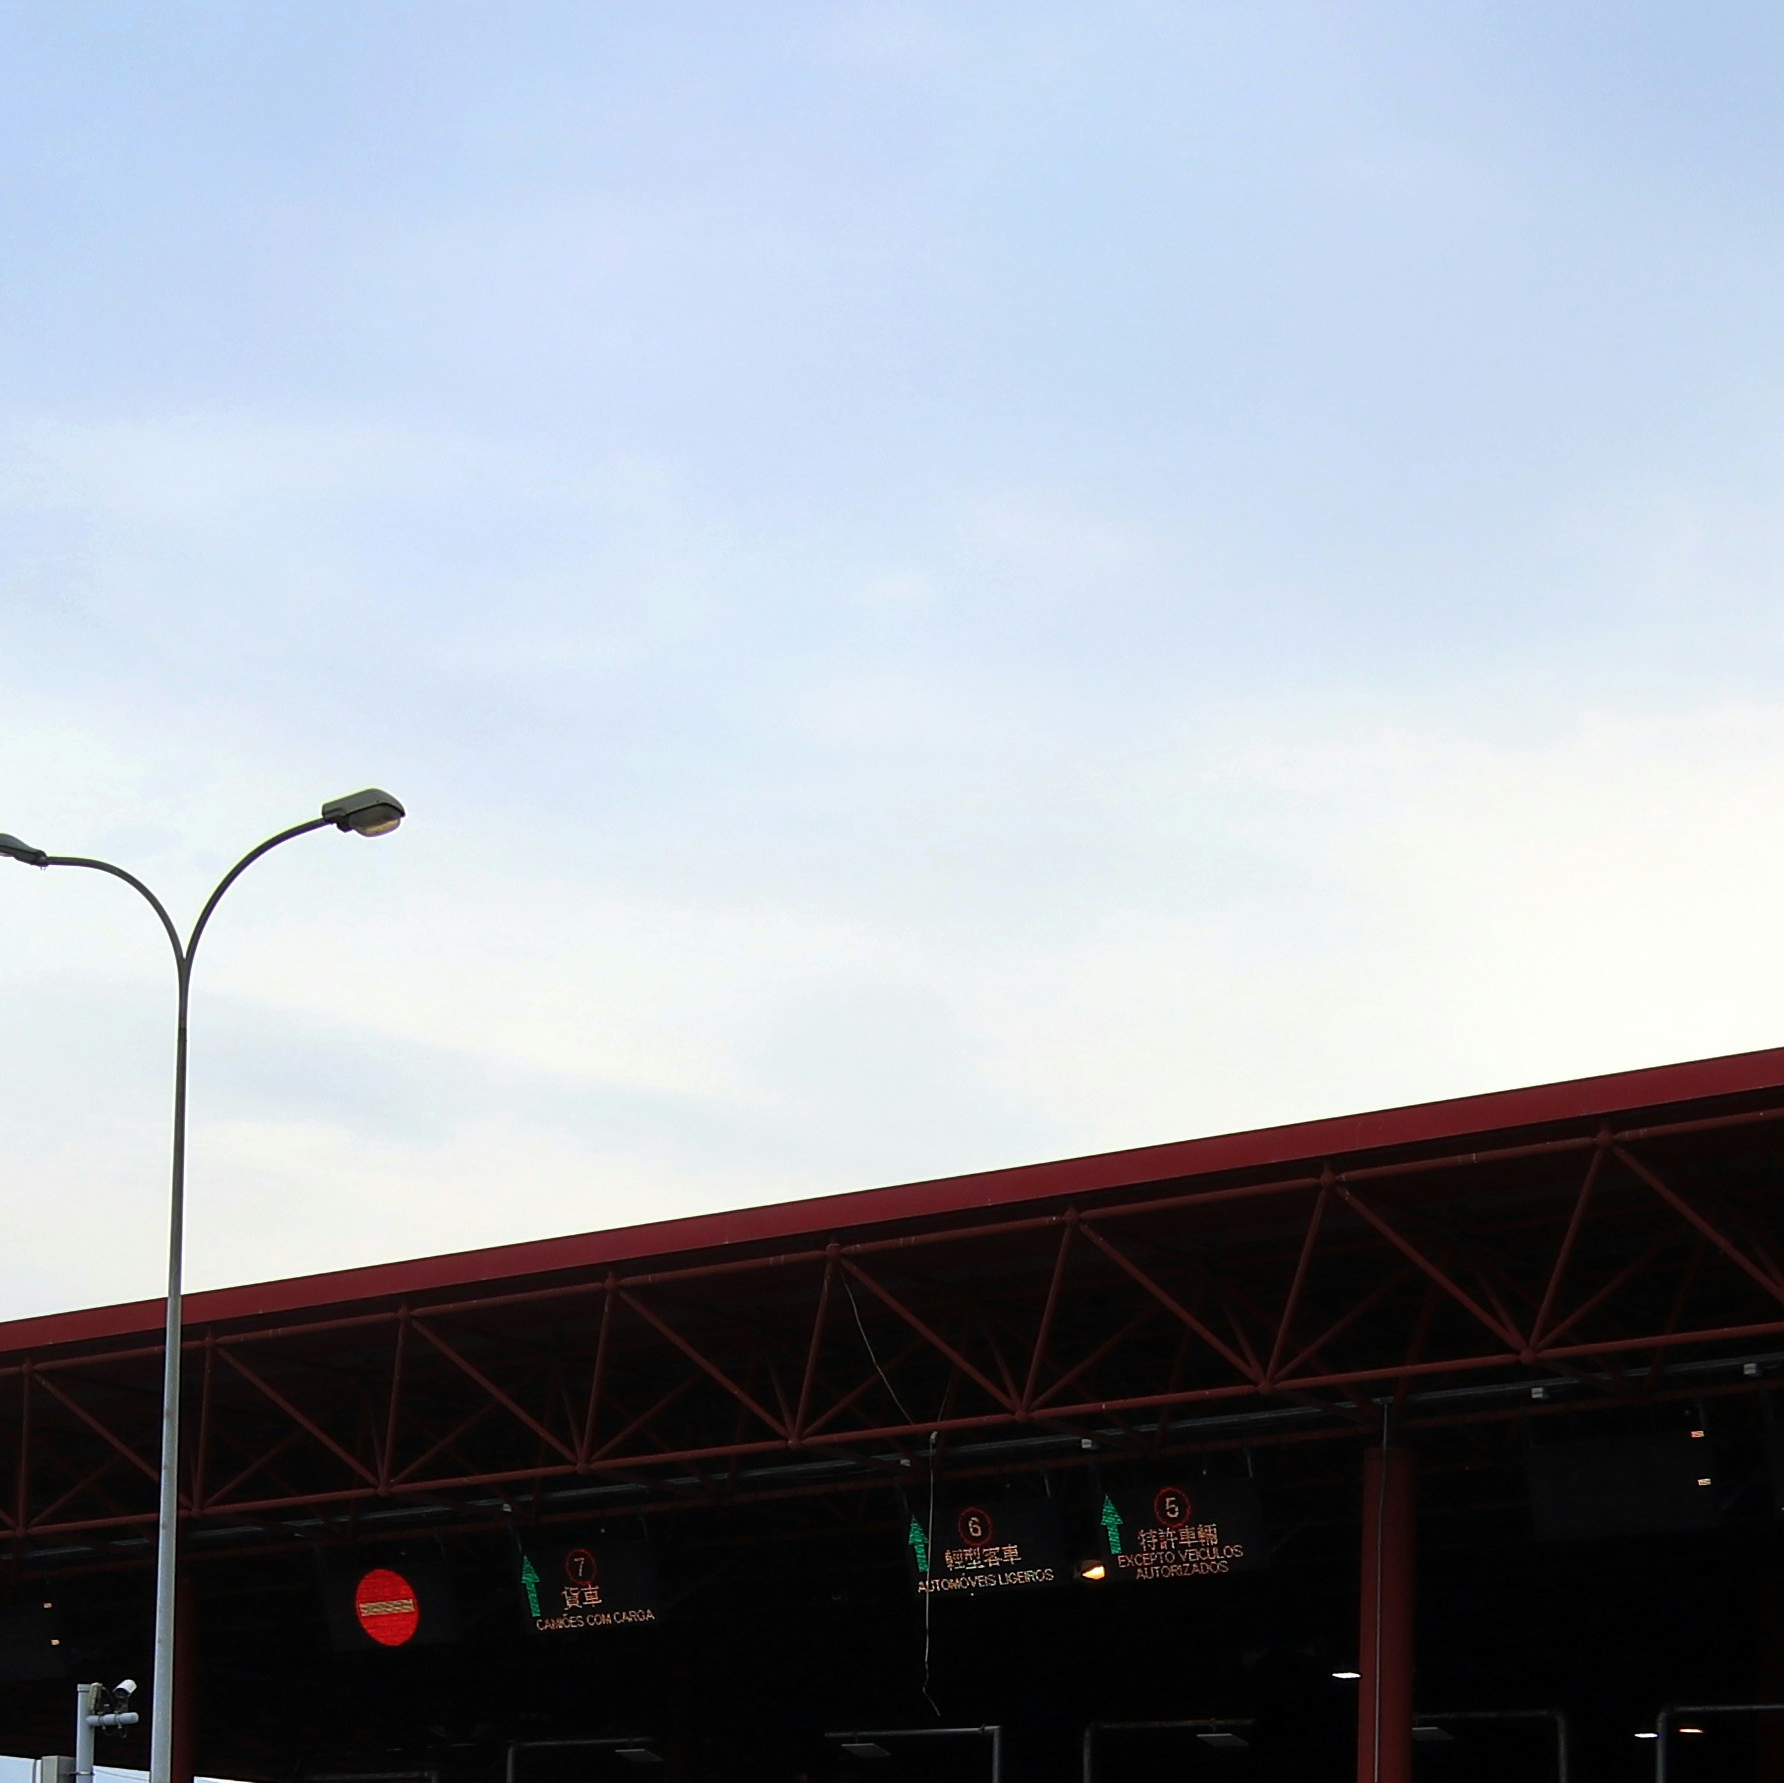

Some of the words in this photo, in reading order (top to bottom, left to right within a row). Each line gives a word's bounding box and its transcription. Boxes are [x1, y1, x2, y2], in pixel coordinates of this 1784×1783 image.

[1165, 1497, 1179, 1518] 5
[968, 1517, 982, 1536] 6
[1138, 1523, 1218, 1551] 特許車輛
[573, 1557, 585, 1577] 7
[945, 1544, 1022, 1571] 輕型客車
[1117, 1551, 1175, 1568] EXCEPTO
[998, 1568, 1054, 1586] LIGEIROS
[1136, 1561, 1229, 1580] AUTORIZADOS
[561, 1584, 603, 1610] 貨車
[586, 1613, 612, 1627] COM
[613, 1609, 655, 1624] CARGA
